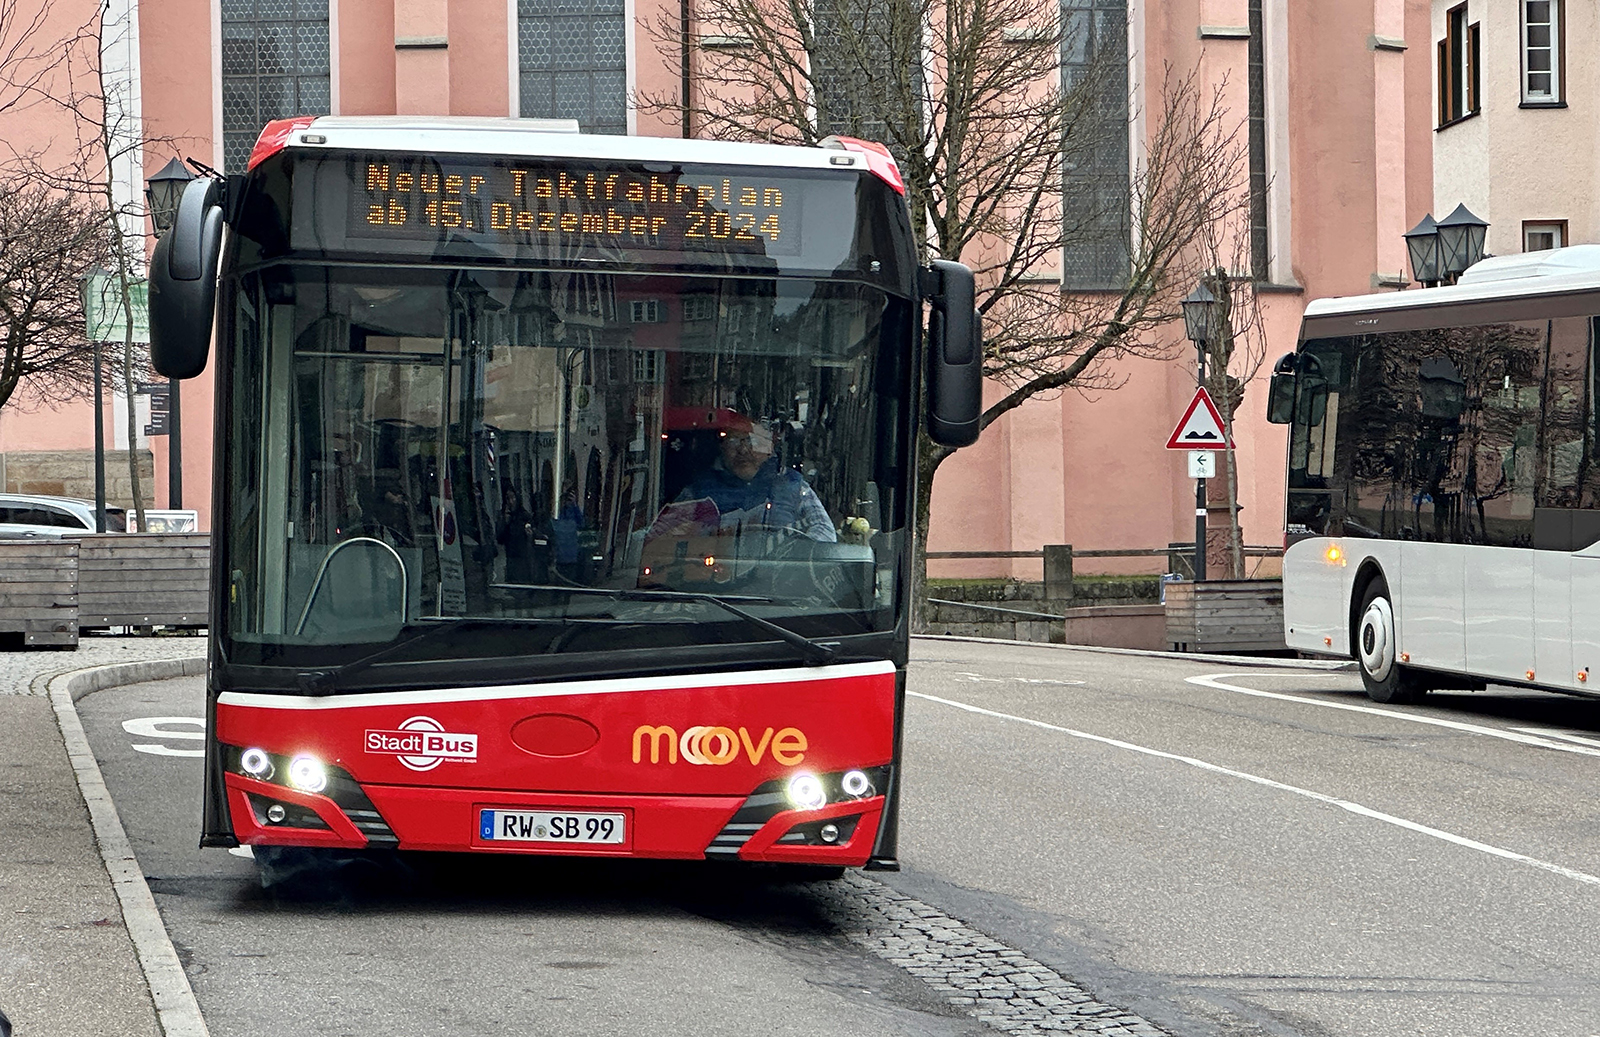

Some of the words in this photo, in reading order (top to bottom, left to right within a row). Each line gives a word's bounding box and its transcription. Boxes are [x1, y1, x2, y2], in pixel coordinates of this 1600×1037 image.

[367, 164, 486, 195] Neuer
[509, 170, 783, 208] Taktfahrplan
[366, 199, 407, 225] ab
[425, 200, 473, 228] 15.
[490, 203, 667, 235] Dezember
[684, 211, 781, 240] 2024
[367, 733, 421, 751] Stadt
[427, 736, 474, 753] Bus
[484, 827, 491, 835] D
[503, 815, 534, 838] RW
[549, 816, 580, 839] SB
[585, 818, 614, 840] 99
